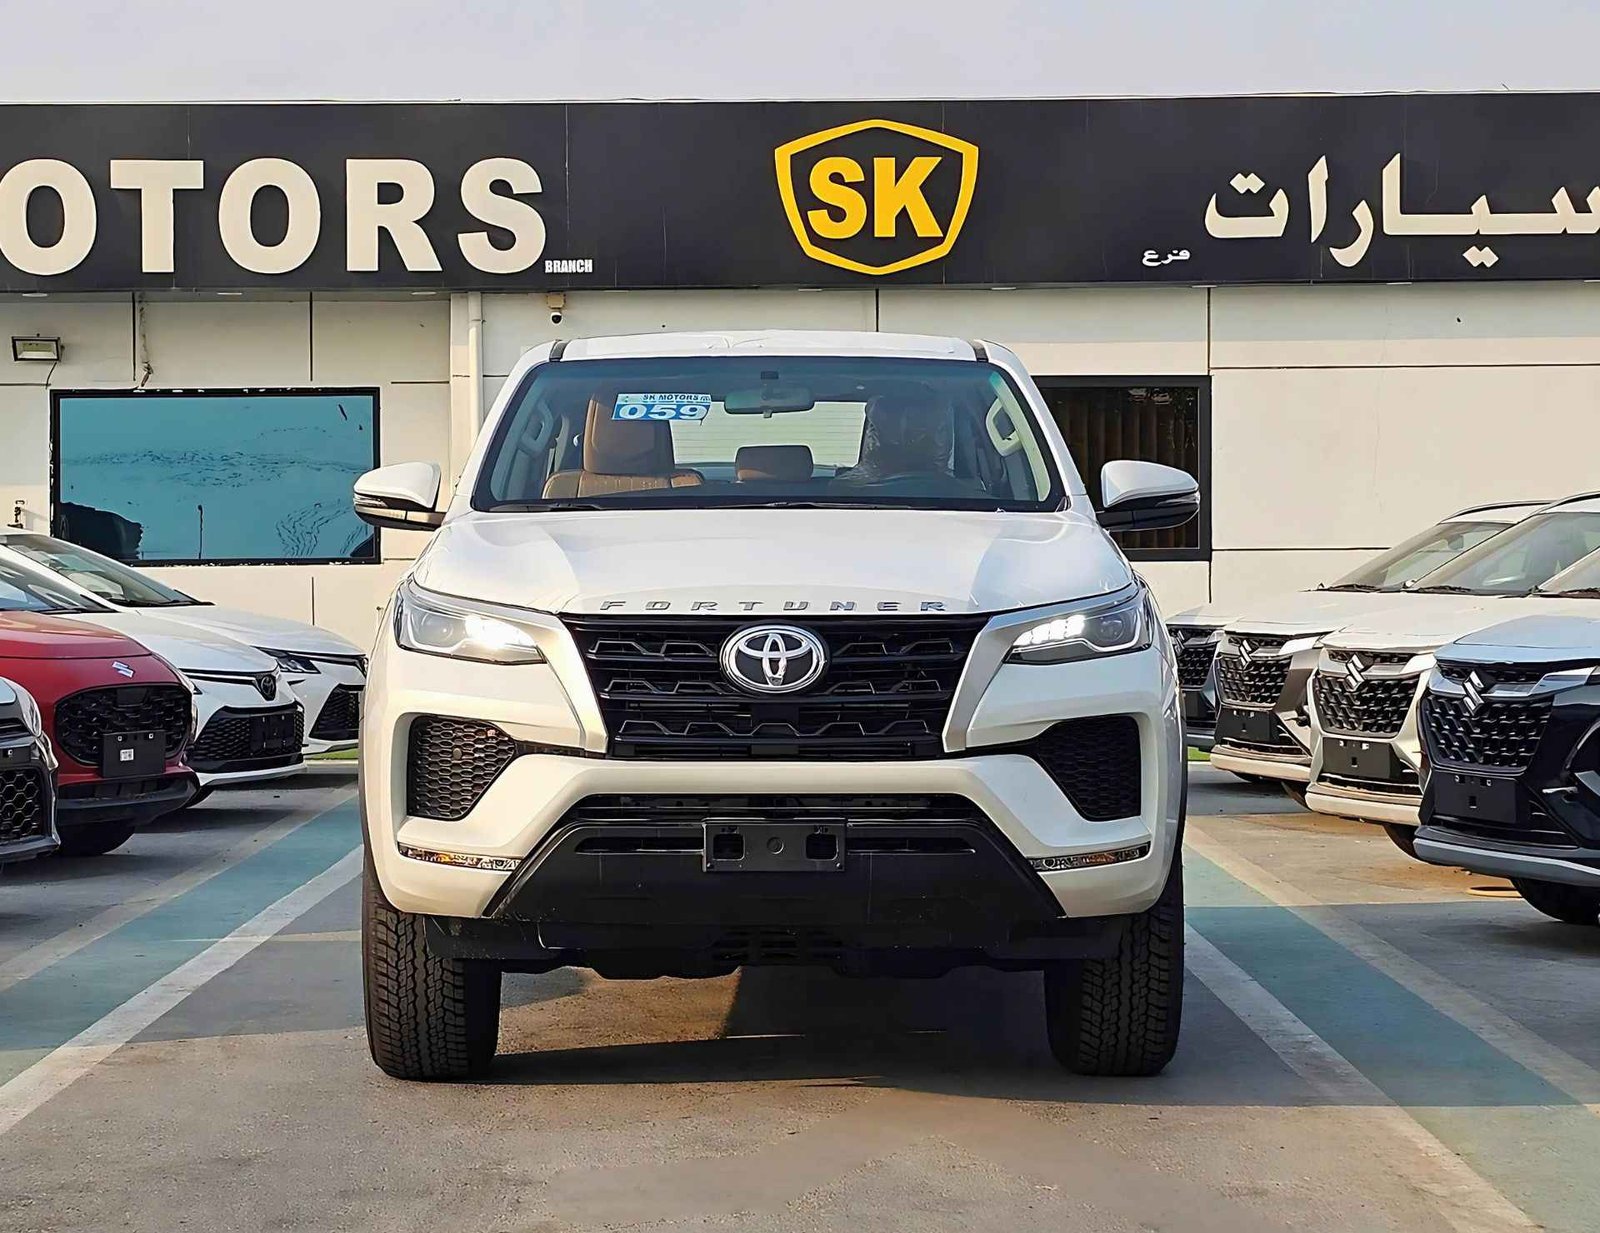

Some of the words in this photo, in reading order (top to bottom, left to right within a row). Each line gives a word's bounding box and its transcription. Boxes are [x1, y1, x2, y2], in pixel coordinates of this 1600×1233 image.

[807, 157, 944, 239] SK
[1142, 249, 1190, 267] فرع
[544, 259, 593, 273] BRANCH
[619, 404, 707, 419] 059
[600, 600, 946, 611] FORTUNER
